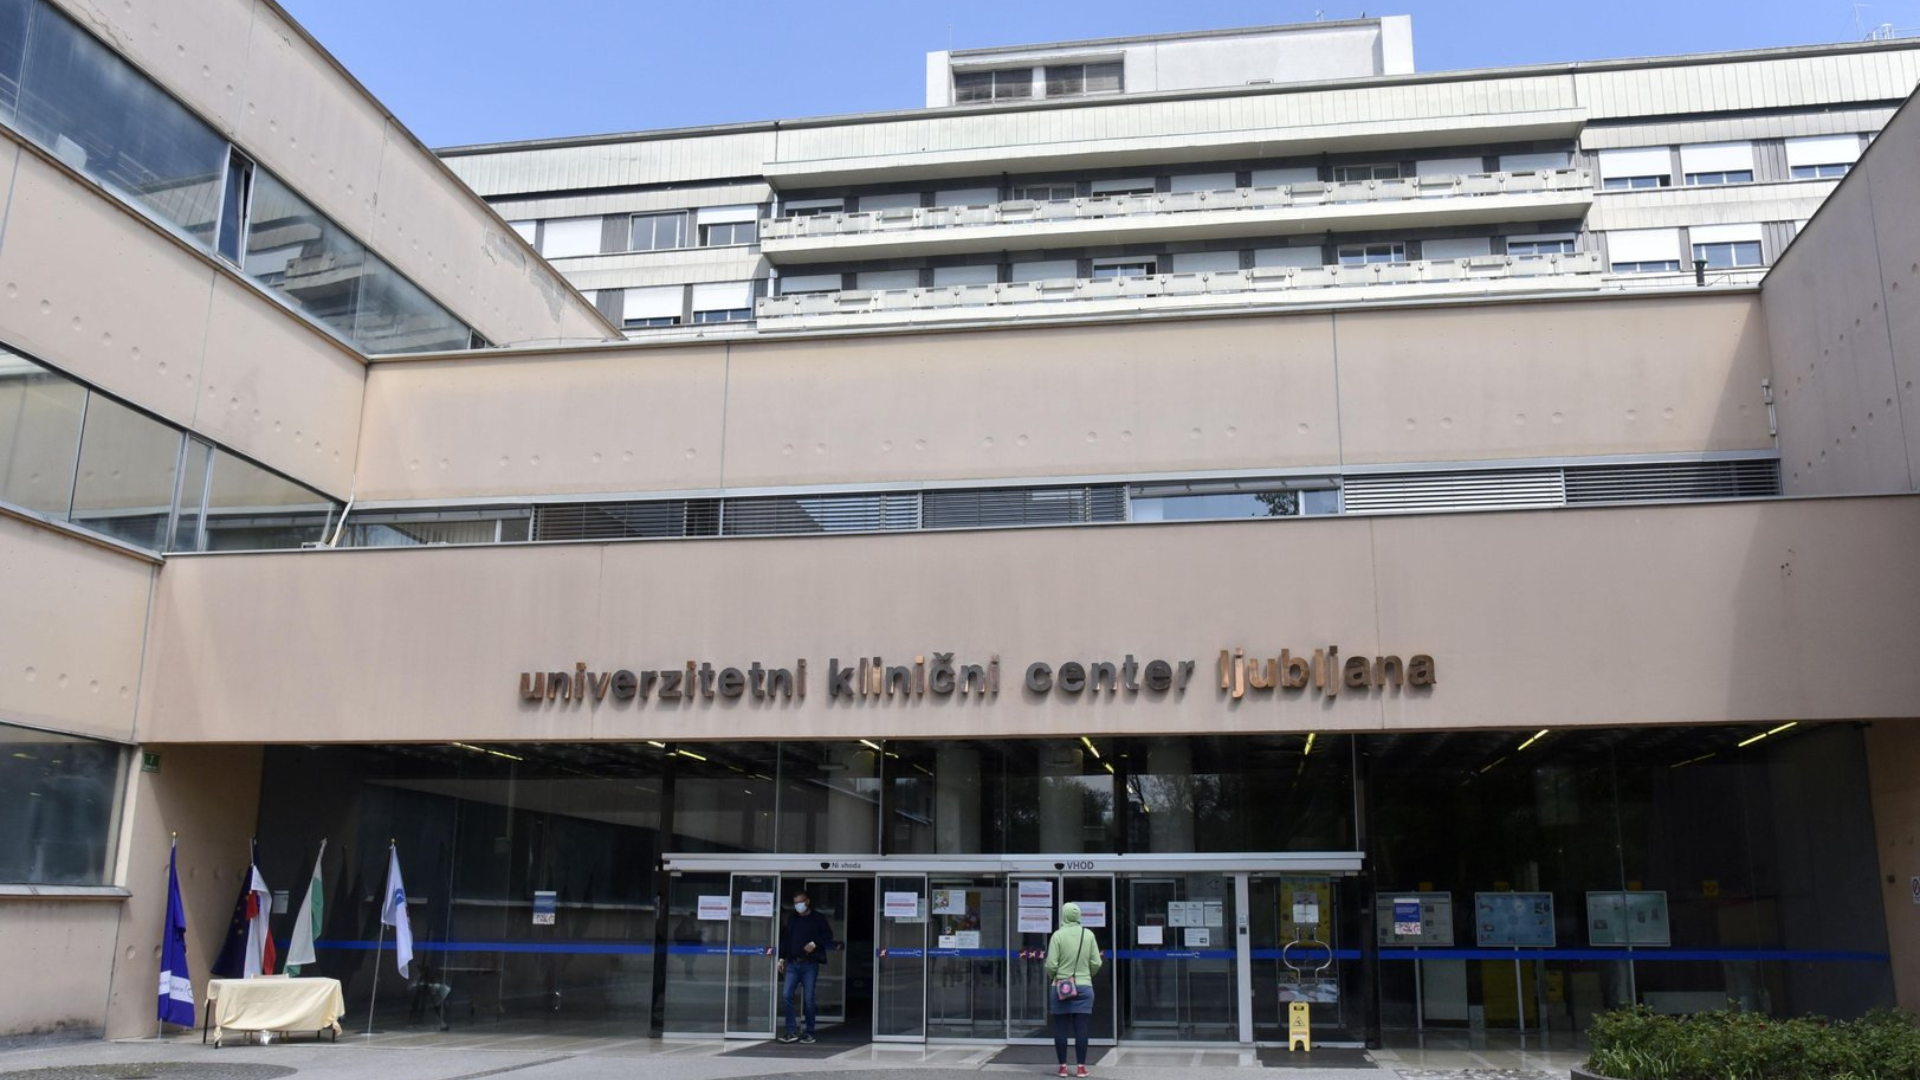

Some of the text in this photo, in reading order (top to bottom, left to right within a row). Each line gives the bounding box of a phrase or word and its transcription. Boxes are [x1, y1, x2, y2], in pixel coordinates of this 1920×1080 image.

[519, 645, 1436, 700] univerzitetni klinični center ljubljana
[1067, 861, 1094, 870] VHOD
